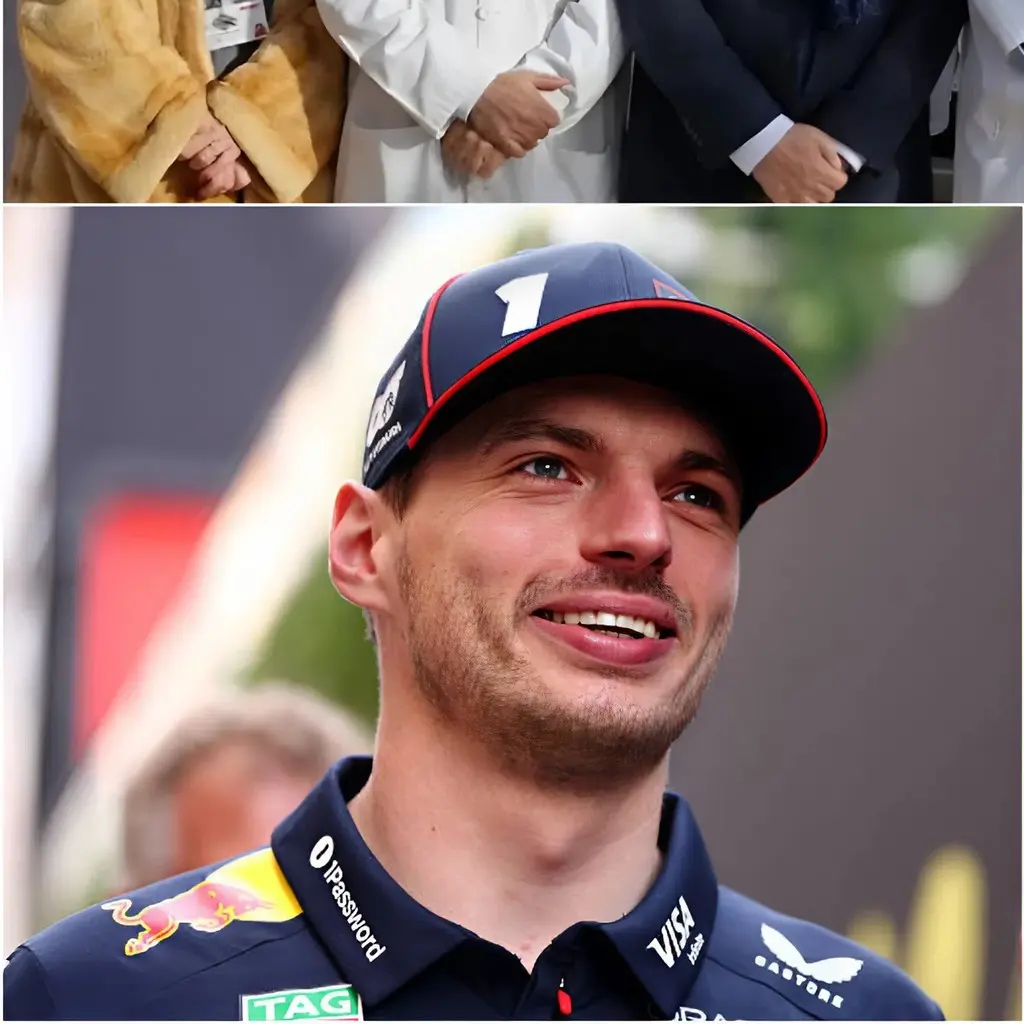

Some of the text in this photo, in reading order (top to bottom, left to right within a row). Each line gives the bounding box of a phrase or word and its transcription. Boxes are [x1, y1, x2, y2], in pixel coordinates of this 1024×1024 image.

[494, 272, 549, 337] 1
[323, 859, 387, 963] 1Password
[646, 895, 695, 969] VISA
[253, 989, 352, 1021] TAG
